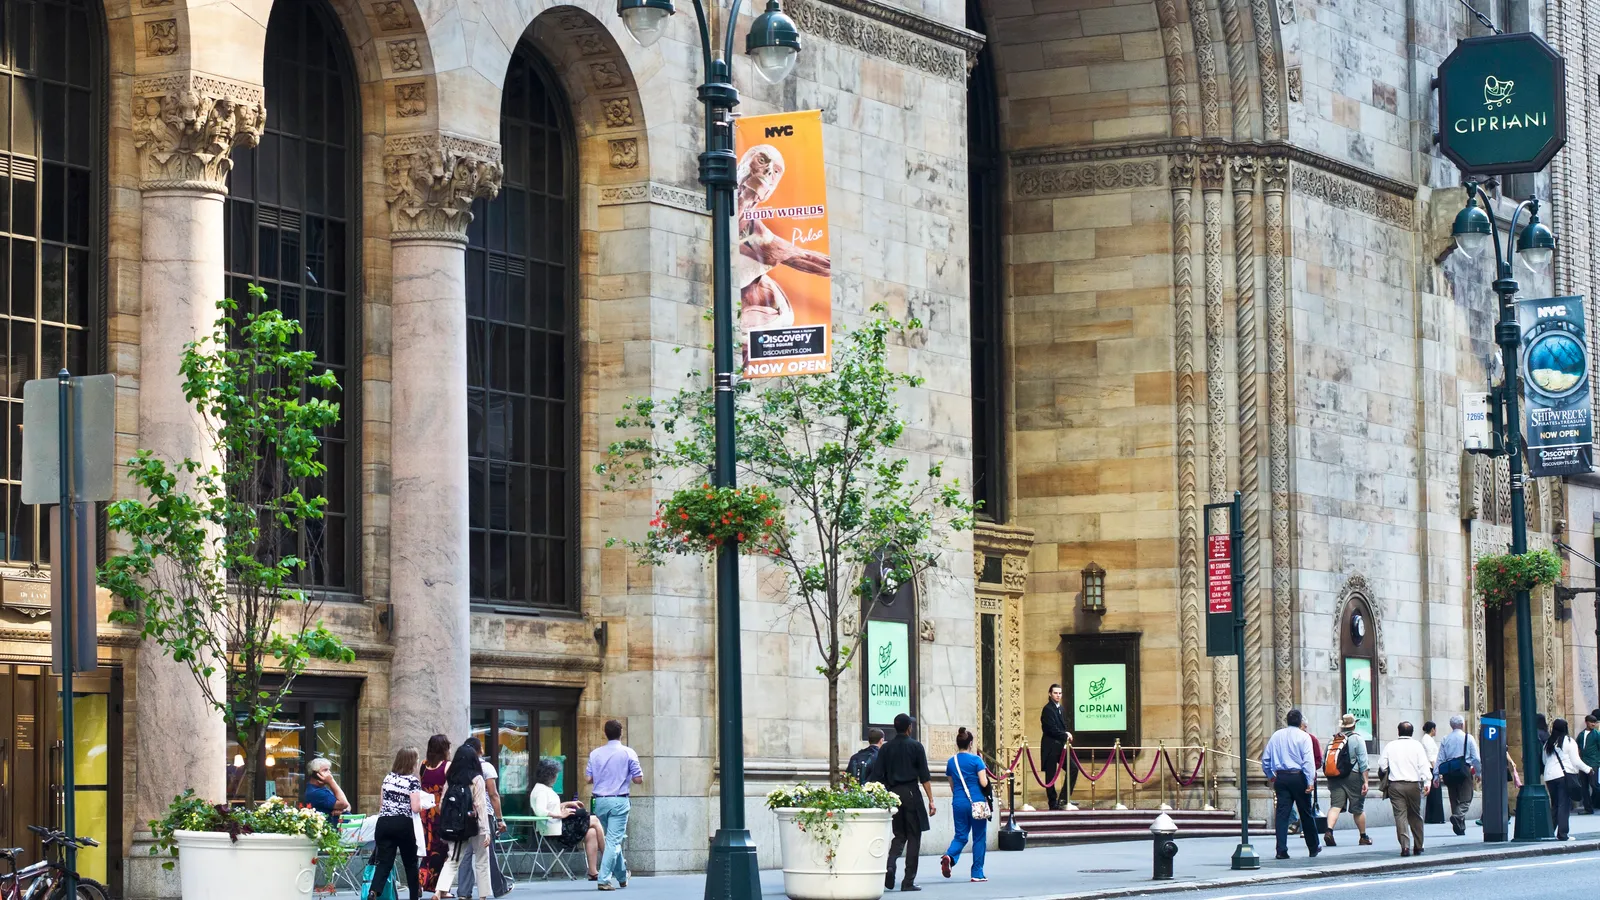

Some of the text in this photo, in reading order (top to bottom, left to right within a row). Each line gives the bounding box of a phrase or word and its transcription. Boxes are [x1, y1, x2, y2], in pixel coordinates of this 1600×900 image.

[1454, 111, 1547, 134] CIPRIANI
[764, 124, 794, 138] NYC
[744, 209, 774, 220] BODY
[776, 205, 824, 218] WORLDS
[791, 227, 824, 246] Pulse
[1537, 305, 1567, 318] NYC
[759, 333, 812, 344] Discovery
[763, 348, 812, 356] DISCOVERYTS.COM
[748, 359, 826, 376] NOW OPEN
[1466, 412, 1485, 421] 72695
[1531, 409, 1587, 427] SHIPWRECK!
[1540, 430, 1580, 439] NOW OPEN
[1539, 450, 1579, 458] Discovery
[1477, 527, 1489, 540] ONE
[870, 684, 906, 698] CIPRIANI
[1079, 704, 1123, 713] CIPRIANI
[1488, 727, 1496, 739] P
